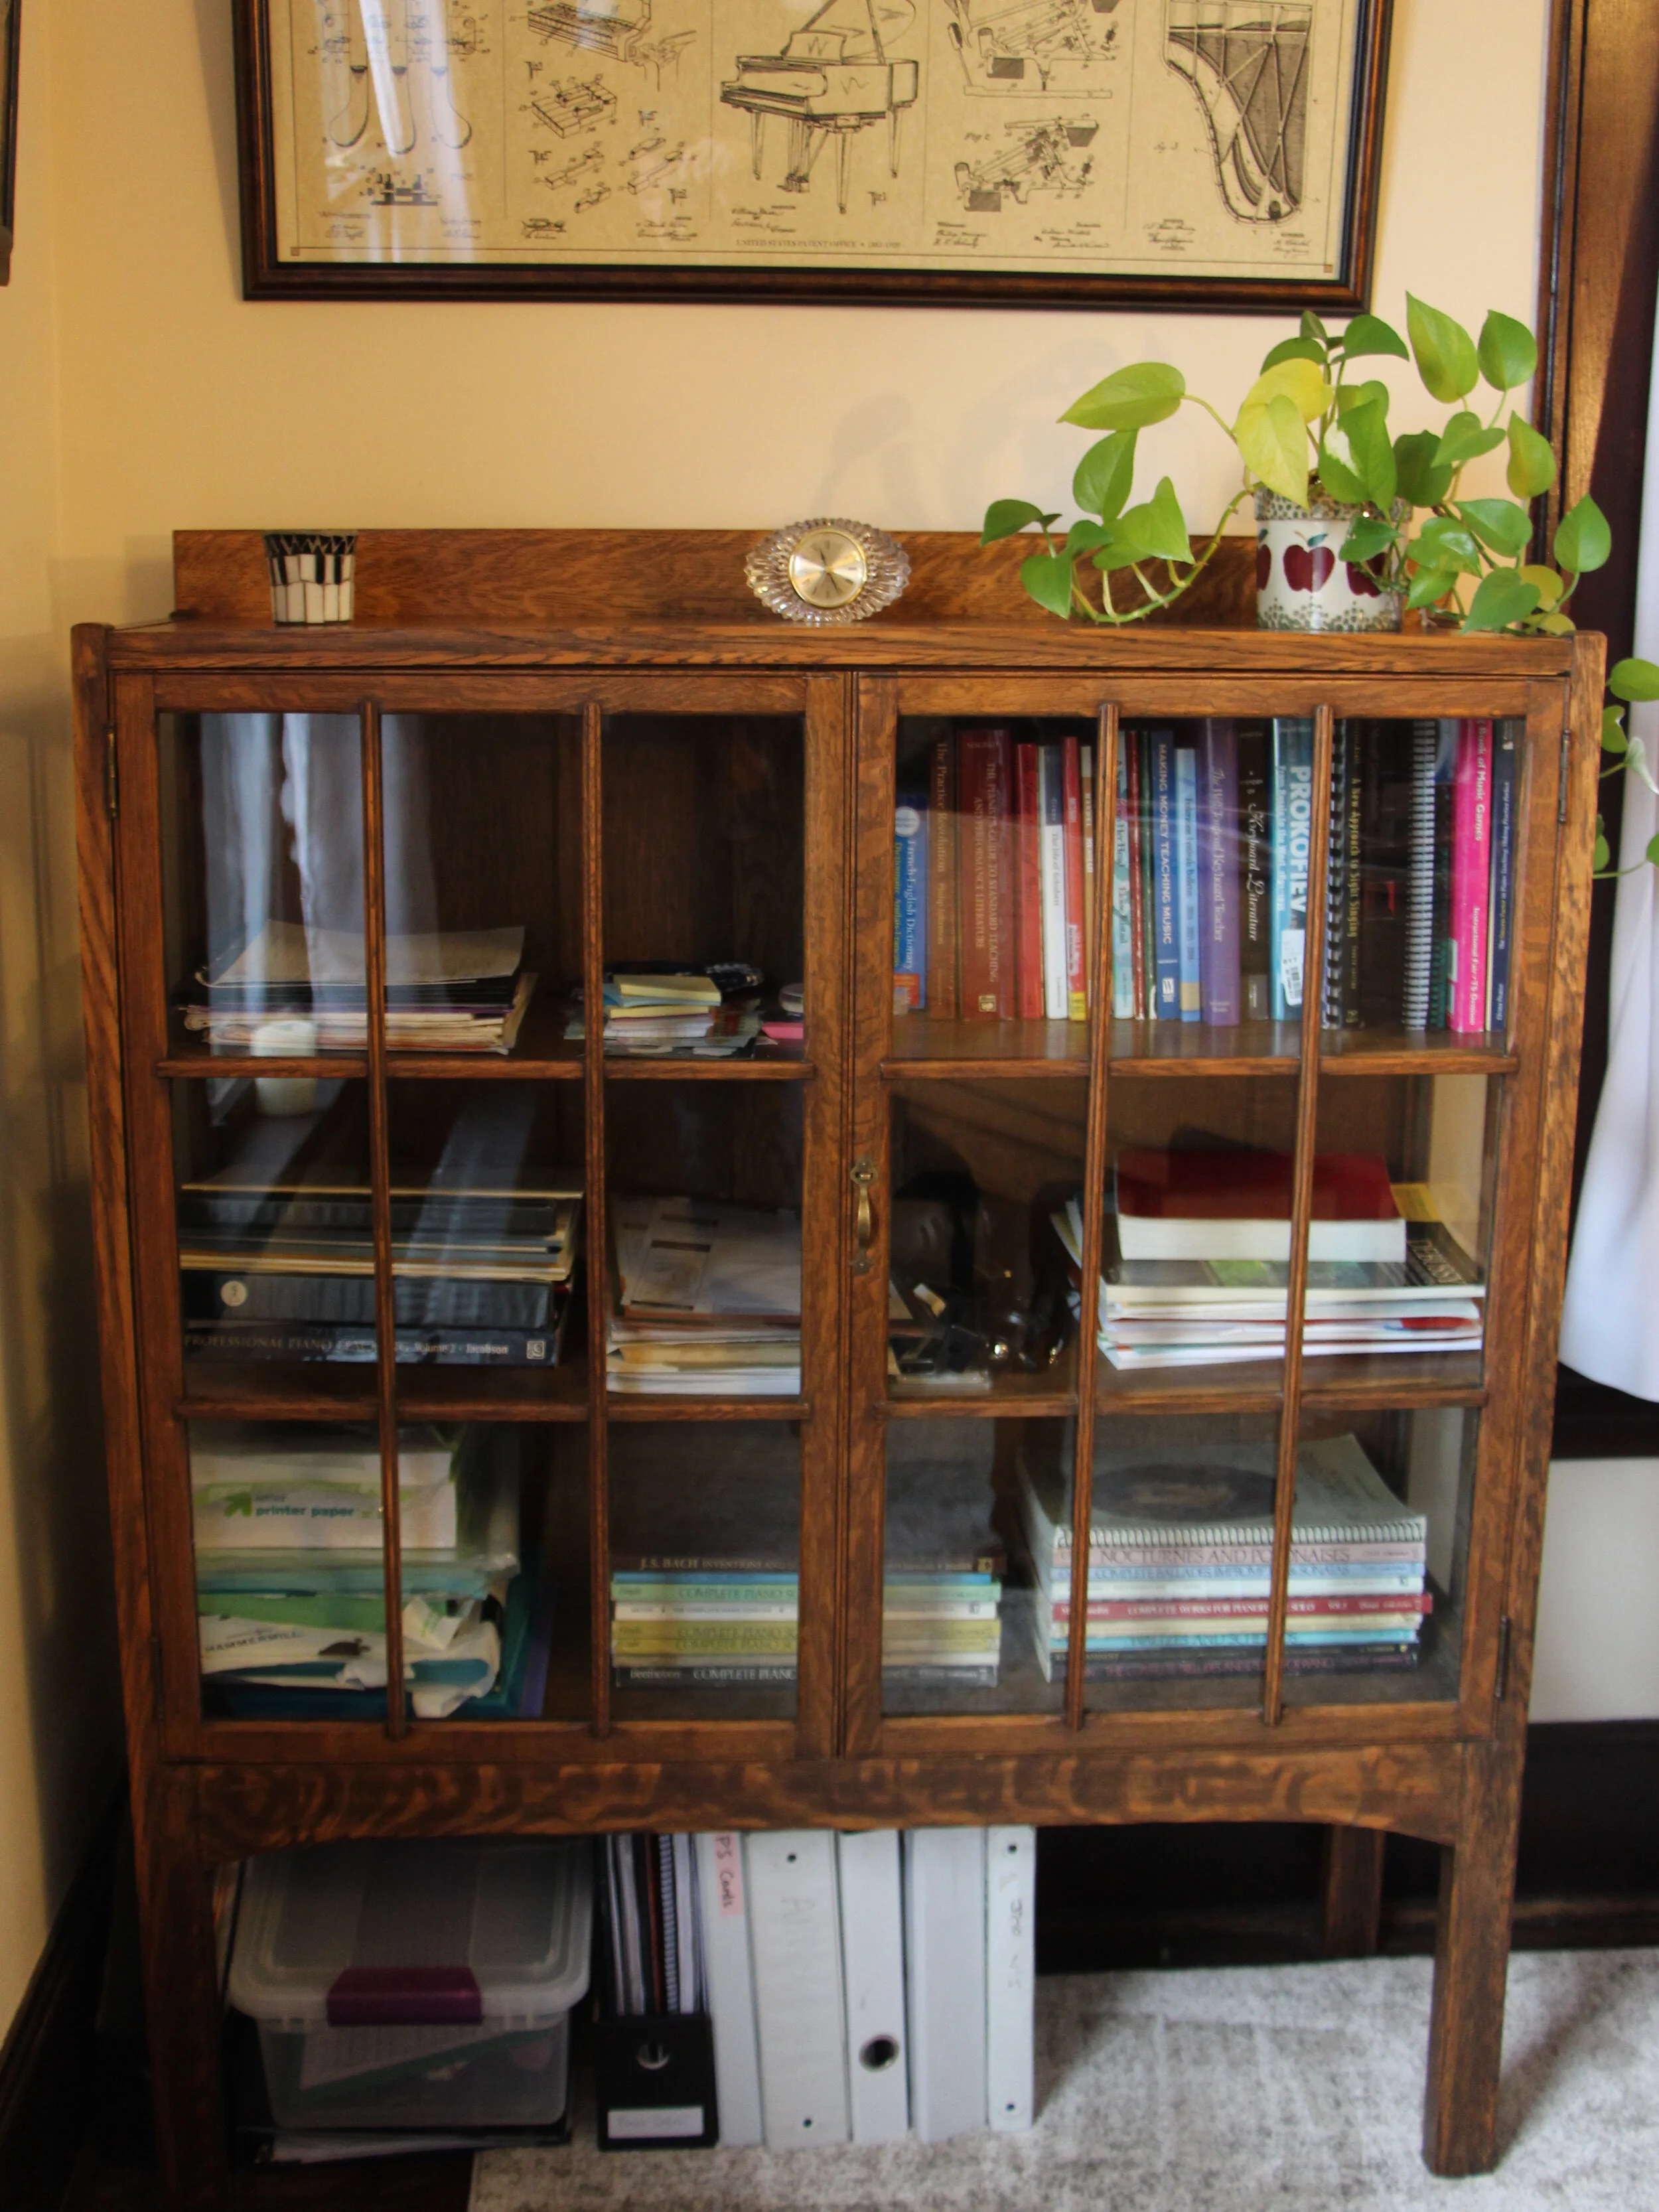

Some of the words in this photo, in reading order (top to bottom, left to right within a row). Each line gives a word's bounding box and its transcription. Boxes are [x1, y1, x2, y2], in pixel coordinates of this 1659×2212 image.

[936, 741, 948, 762] The
[1478, 727, 1487, 755] Book
[987, 763, 997, 780] THE
[1158, 743, 1169, 792] MAKING
[1477, 757, 1487, 769] of
[936, 765, 948, 808] Practice
[1350, 787, 1362, 808] New
[1476, 770, 1486, 800] Music
[974, 798, 983, 818] AND
[1159, 796, 1170, 838] MONEY
[1474, 803, 1486, 842] Games
[936, 812, 949, 873] Revolution
[987, 831, 998, 860] GUIDE
[1248, 803, 1265, 871] Keyboard
[1289, 765, 1312, 913] PROKOFIEV
[1348, 811, 1362, 856] Approach
[988, 863, 999, 877] TO
[1160, 841, 1172, 904] TEACHING
[1212, 854, 1226, 902] Keyboard
[1350, 859, 1360, 869] to
[1347, 872, 1361, 897] Sight
[975, 893, 985, 950] LITERATURE
[988, 879, 999, 931] STANDARD
[1214, 903, 1226, 942] Teacher
[1246, 872, 1266, 942] Literature
[1346, 900, 1360, 937] Singing
[1162, 906, 1173, 945] MUSIC
[902, 919, 917, 970] Dictionary
[989, 934, 999, 983] TEACHING
[184, 1335, 284, 1349] PROFESSIONAL
[289, 1337, 334, 1351] PIANO
[415, 1343, 447, 1355] Volume
[465, 1343, 510, 1355] Jacobson
[255, 1505, 307, 1517] printer
[311, 1507, 356, 1518] paper
[662, 1557, 699, 1569] BACH
[1100, 1547, 1204, 1566] NOCTURNES
[1207, 1548, 1247, 1564] AND
[1251, 1546, 1350, 1564] PONAISES
[678, 1587, 740, 1599] COMPLETE
[744, 1587, 783, 1600] PIANO
[630, 1668, 682, 1680] Beethoven
[693, 1668, 757, 1681] COMPLETE
